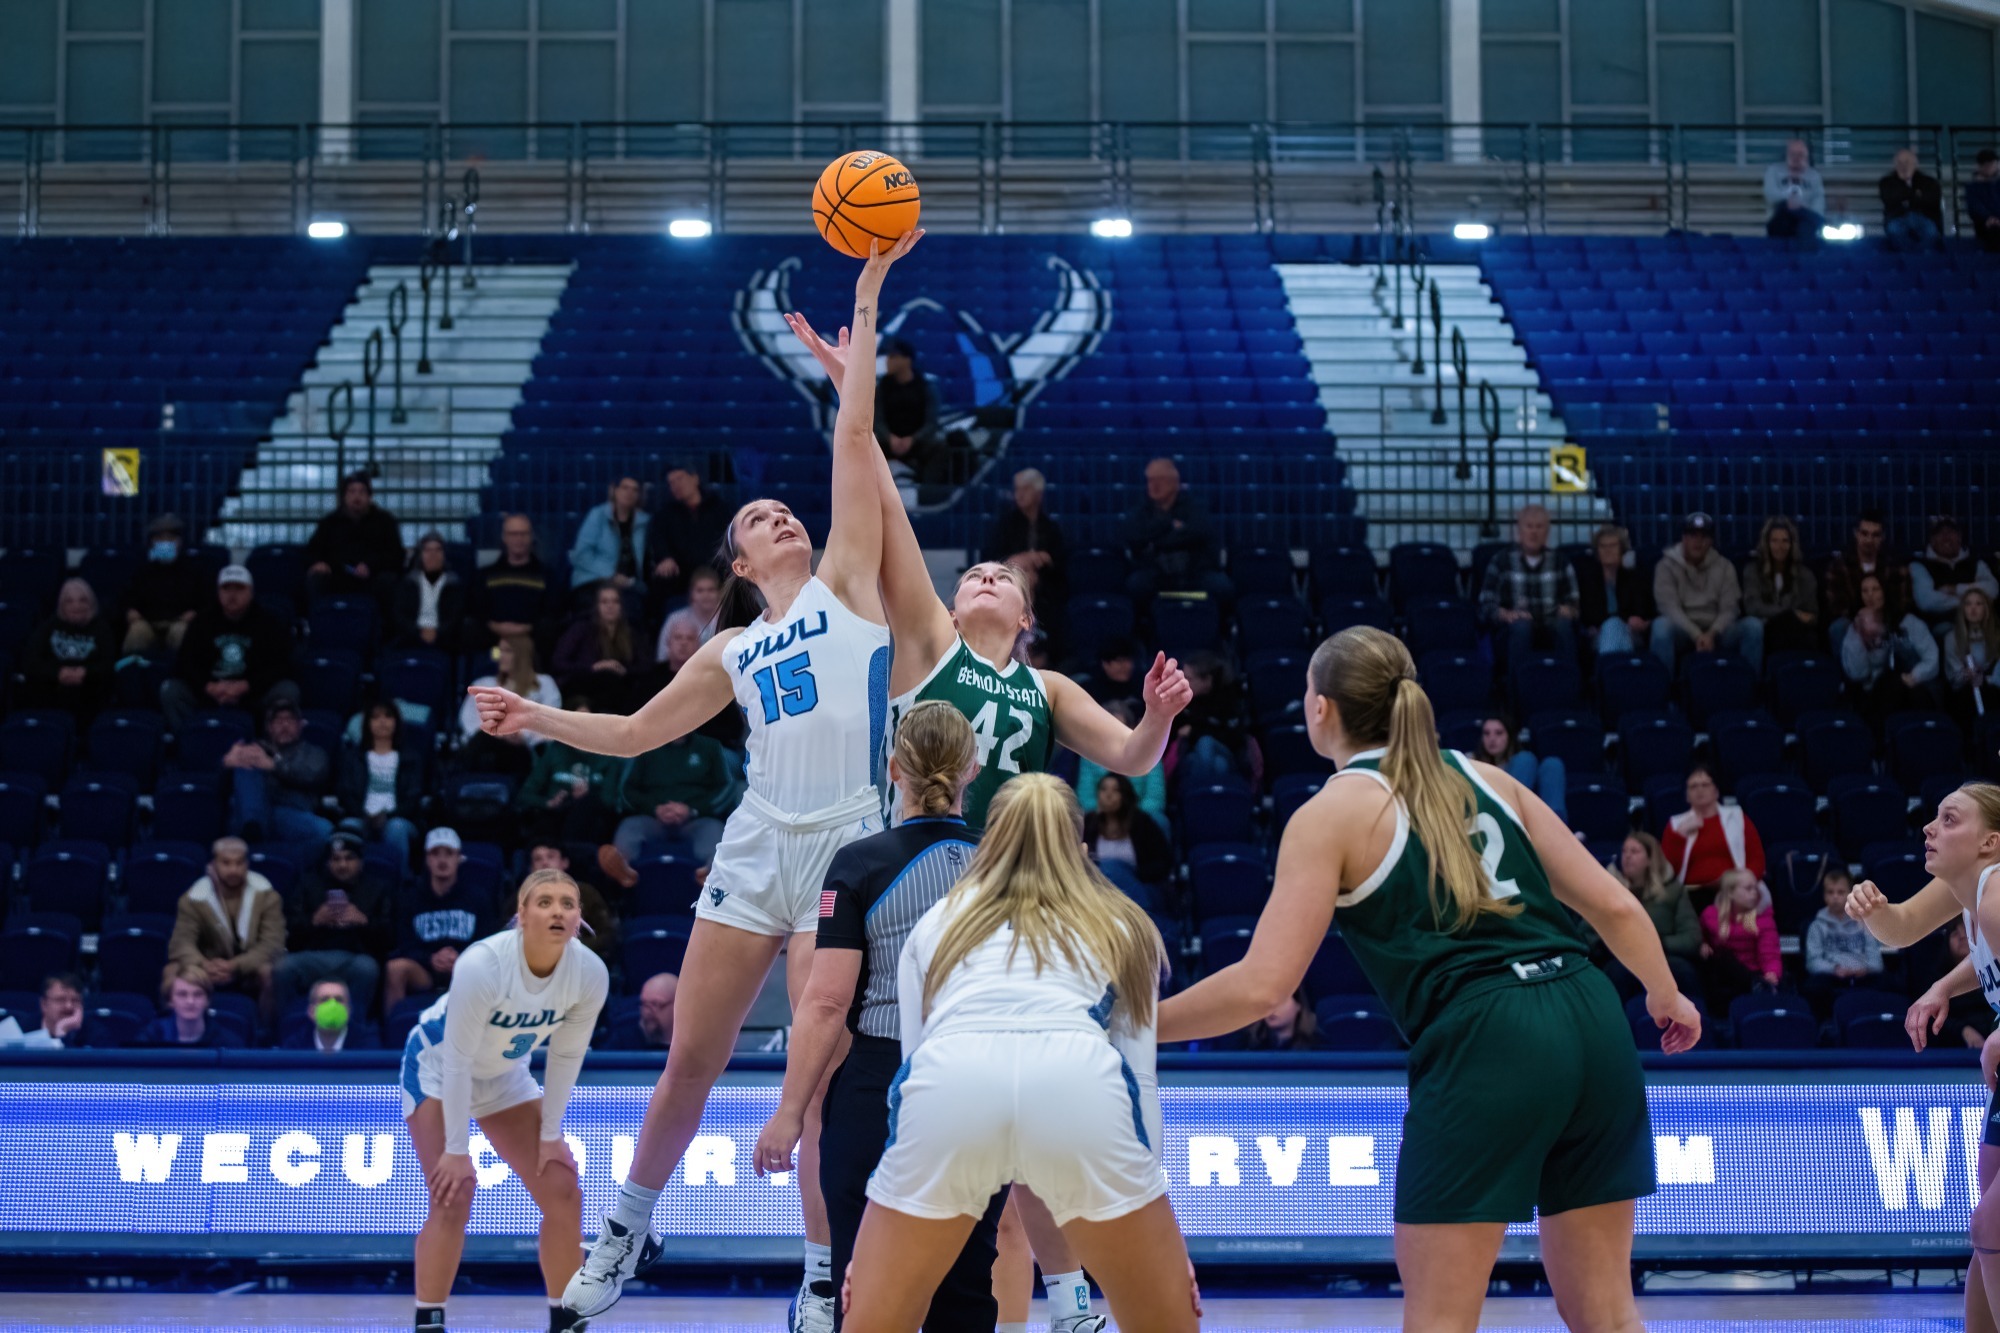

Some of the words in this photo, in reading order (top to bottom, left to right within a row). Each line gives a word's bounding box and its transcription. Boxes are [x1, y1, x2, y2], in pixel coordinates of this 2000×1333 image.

[738, 610, 828, 676] WWU
[752, 650, 819, 725] 15
[970, 700, 1033, 774] 42
[413, 910, 476, 942] WESTERN
[503, 1033, 537, 1059] 3
[114, 1131, 395, 1187] WECU
